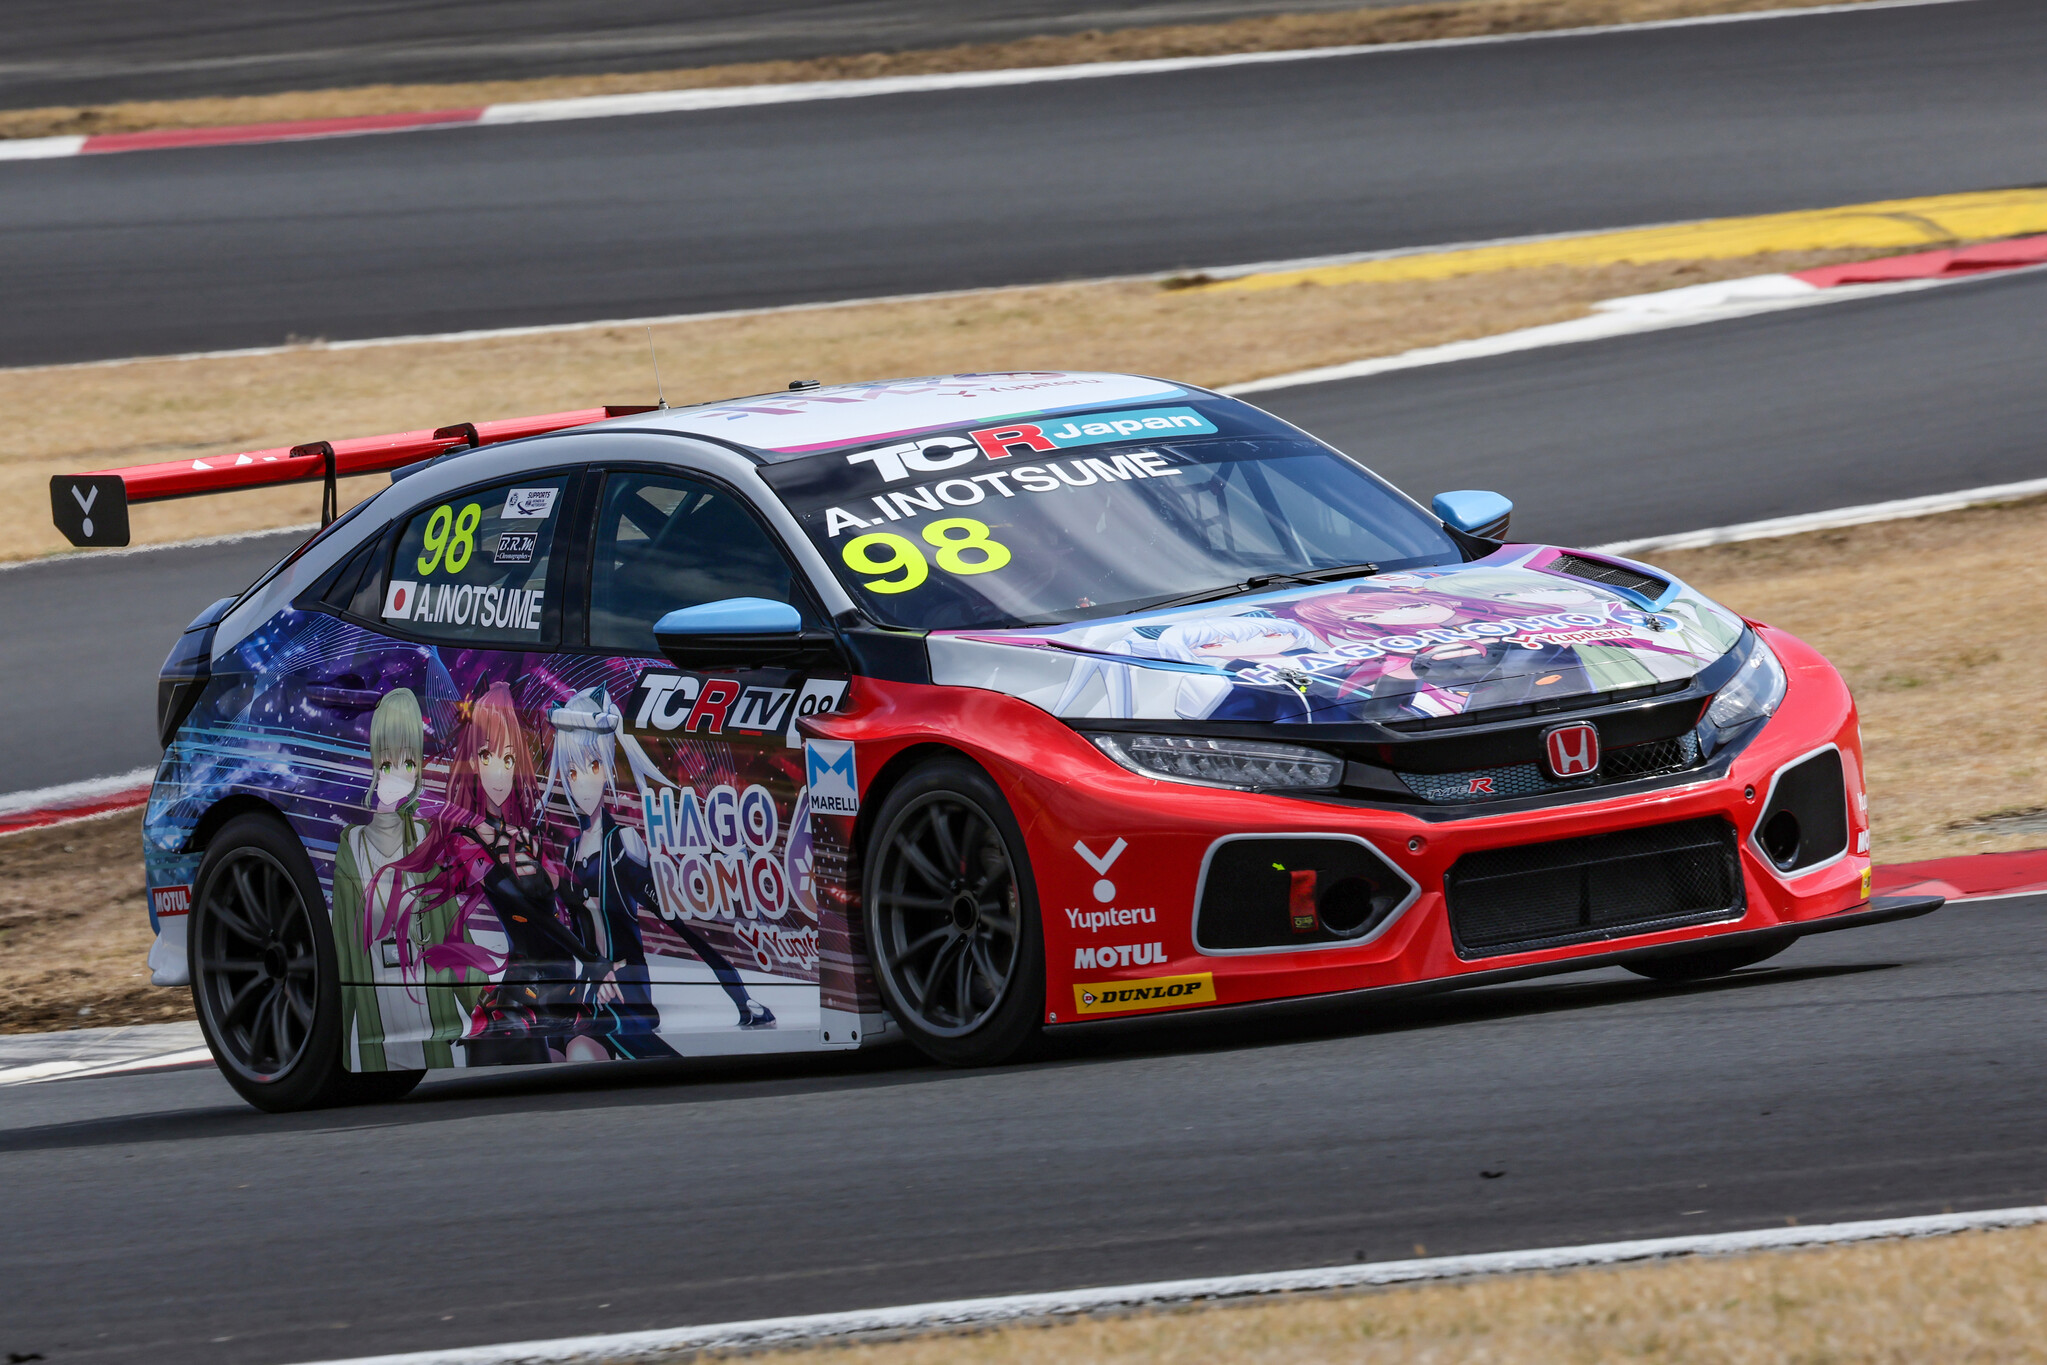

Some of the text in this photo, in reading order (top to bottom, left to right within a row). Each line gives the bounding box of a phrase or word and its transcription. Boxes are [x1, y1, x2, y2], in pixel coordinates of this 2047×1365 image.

[846, 410, 1203, 483] TCR Japan
[527, 491, 551, 499] SUPPORTS
[826, 452, 1182, 537] A.INOTSUME
[417, 503, 482, 576] 98
[842, 517, 1012, 594] 98
[413, 583, 545, 630] A.INOTSUME
[1540, 628, 1633, 644] Yupiteru
[635, 673, 741, 735] TCR
[738, 690, 792, 729] TV
[811, 795, 858, 813] MARELLI
[1468, 778, 1495, 793] R
[643, 786, 777, 852] HAGO
[155, 891, 190, 912] MOTUL
[652, 853, 787, 919] ROMO
[1065, 907, 1156, 932] Yupiteru
[1074, 942, 1167, 969] MOTUL
[1100, 982, 1202, 1003] DUNLOP
